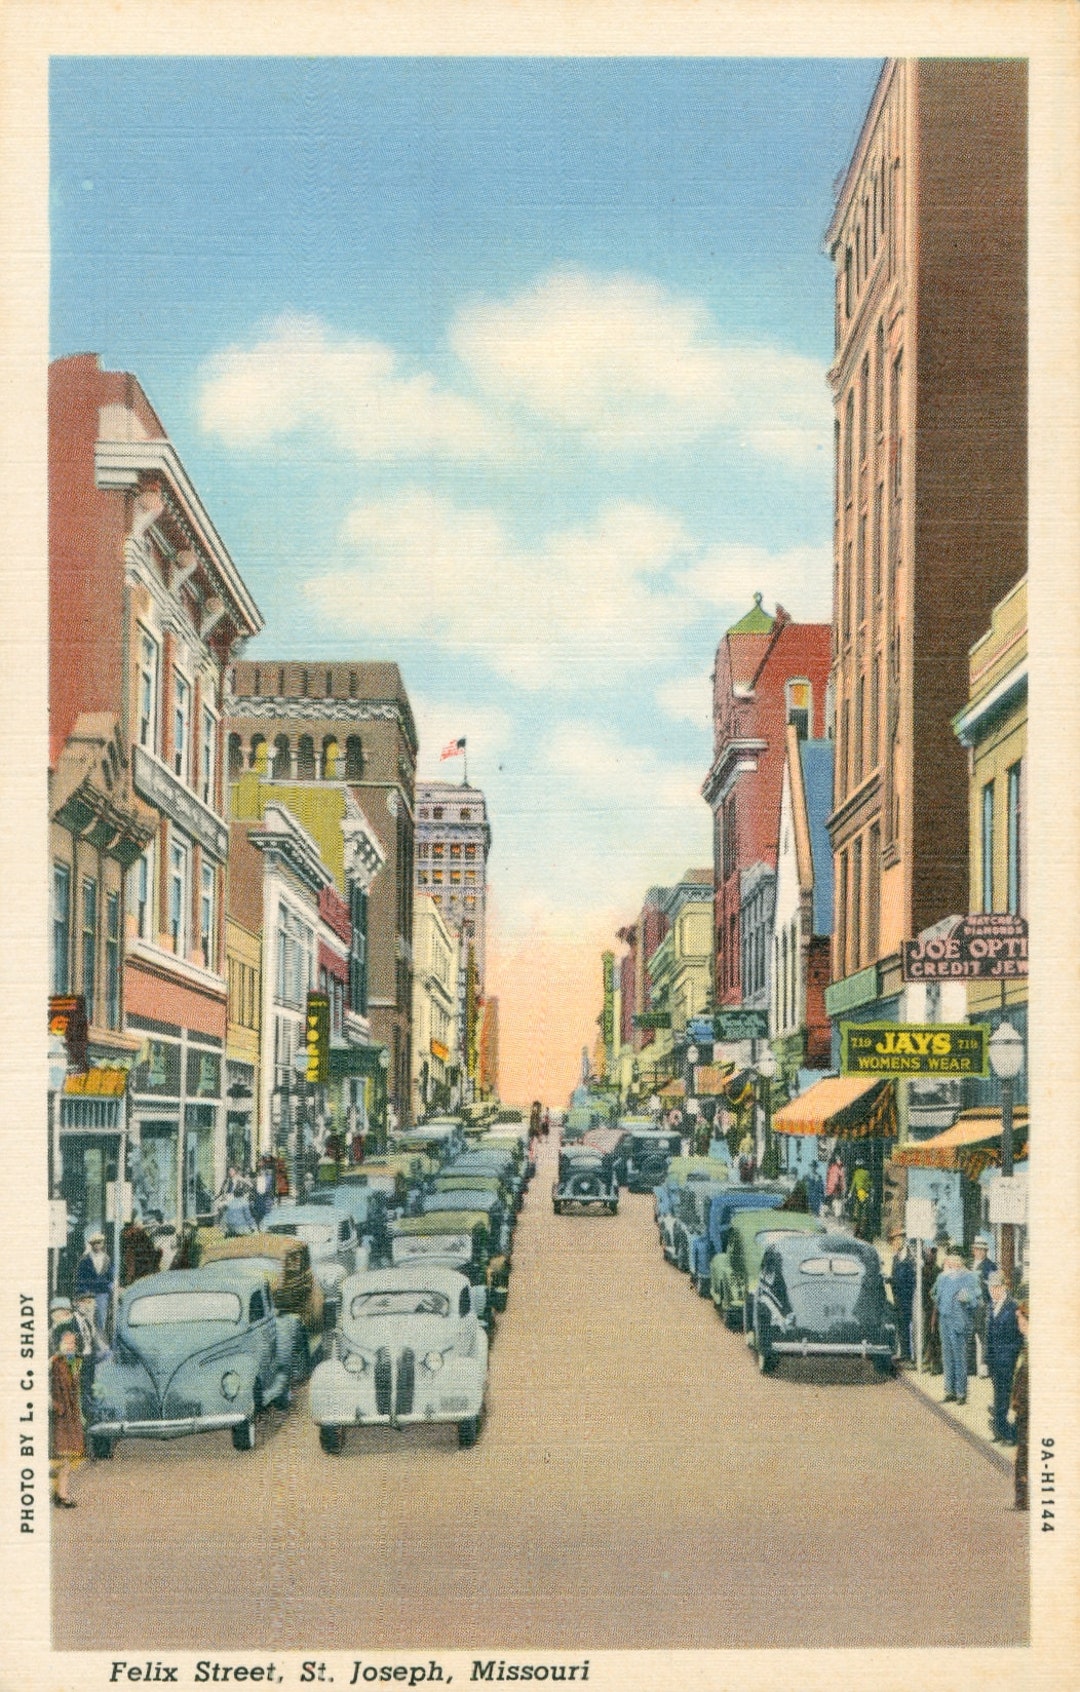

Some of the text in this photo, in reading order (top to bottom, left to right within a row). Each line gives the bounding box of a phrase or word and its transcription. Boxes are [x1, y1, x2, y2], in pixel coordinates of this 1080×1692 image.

[910, 938, 960, 959] JOE
[911, 961, 980, 976] CREDIT
[875, 1032, 952, 1055] JAYS
[858, 1056, 972, 1070] WOMENS WEAR
